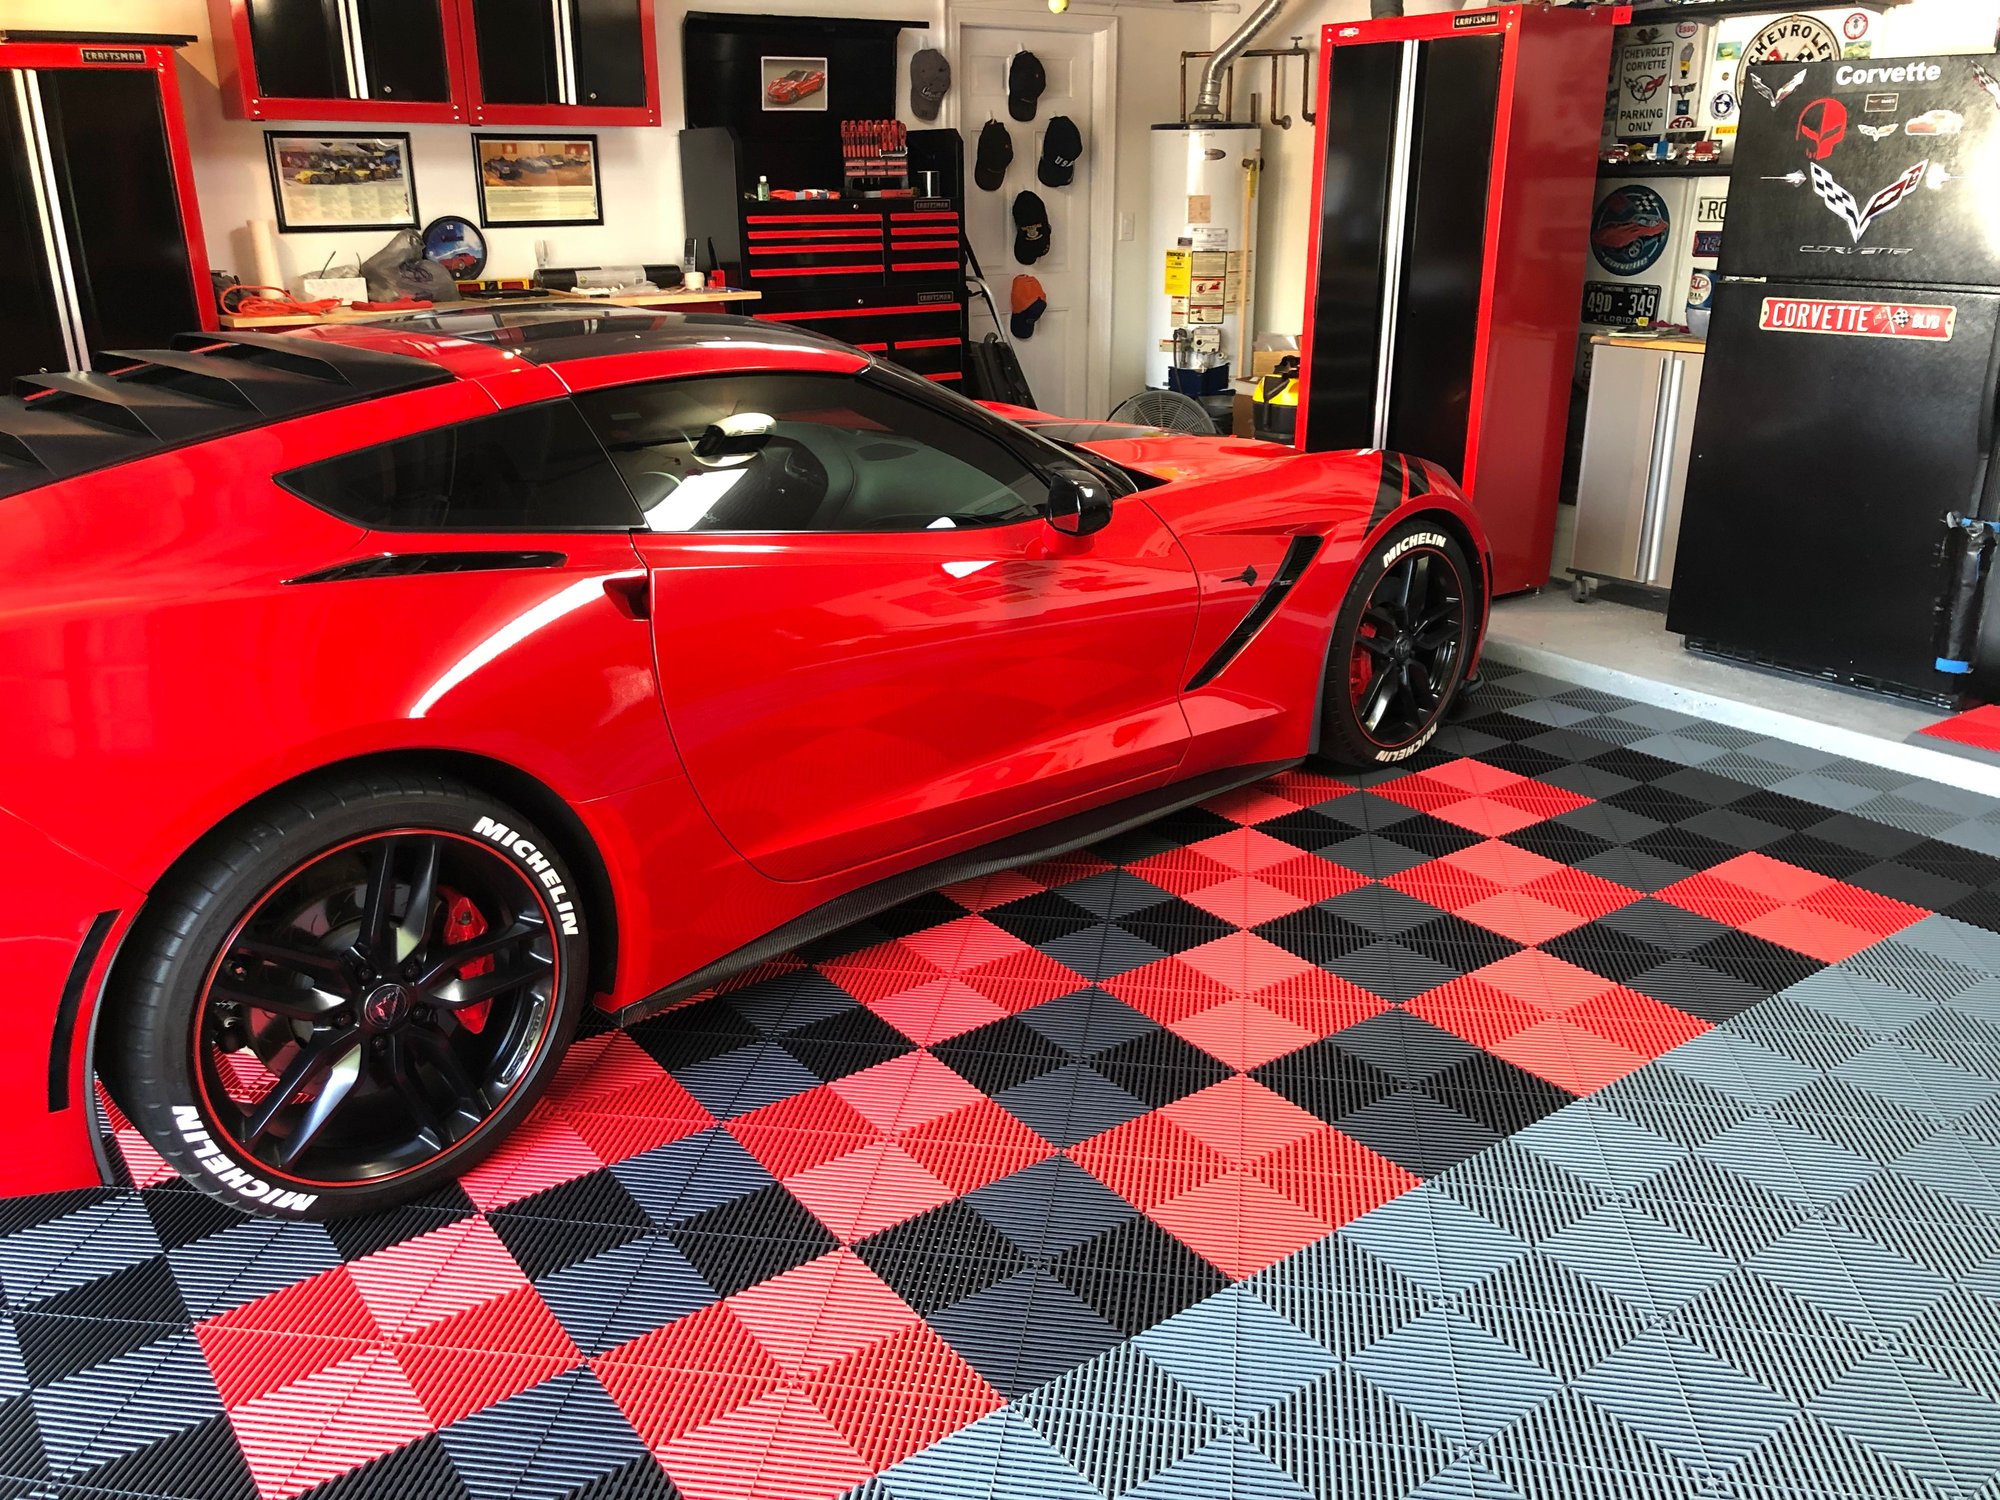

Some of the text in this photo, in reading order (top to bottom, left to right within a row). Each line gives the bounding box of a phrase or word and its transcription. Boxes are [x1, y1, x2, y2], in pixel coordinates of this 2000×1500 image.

[1455, 14, 1497, 26] CRAFTSMAN
[84, 51, 143, 61] CRAFTSMAN
[1624, 46, 1671, 59] CHEVROLET
[1749, 24, 1833, 65] CHEVROLET
[1625, 60, 1667, 72] CORVETTE
[1836, 61, 1942, 86] Corvette
[1620, 108, 1663, 120] PARKING
[1628, 121, 1653, 132] ONLY
[1628, 294, 1656, 317] 349
[1772, 303, 1874, 332] CORVETTE
[1382, 532, 1447, 569] MICHELIN
[1375, 721, 1438, 762] MICHELIN
[472, 815, 579, 935] MICHELIN
[171, 1105, 320, 1212] MICHELIN
